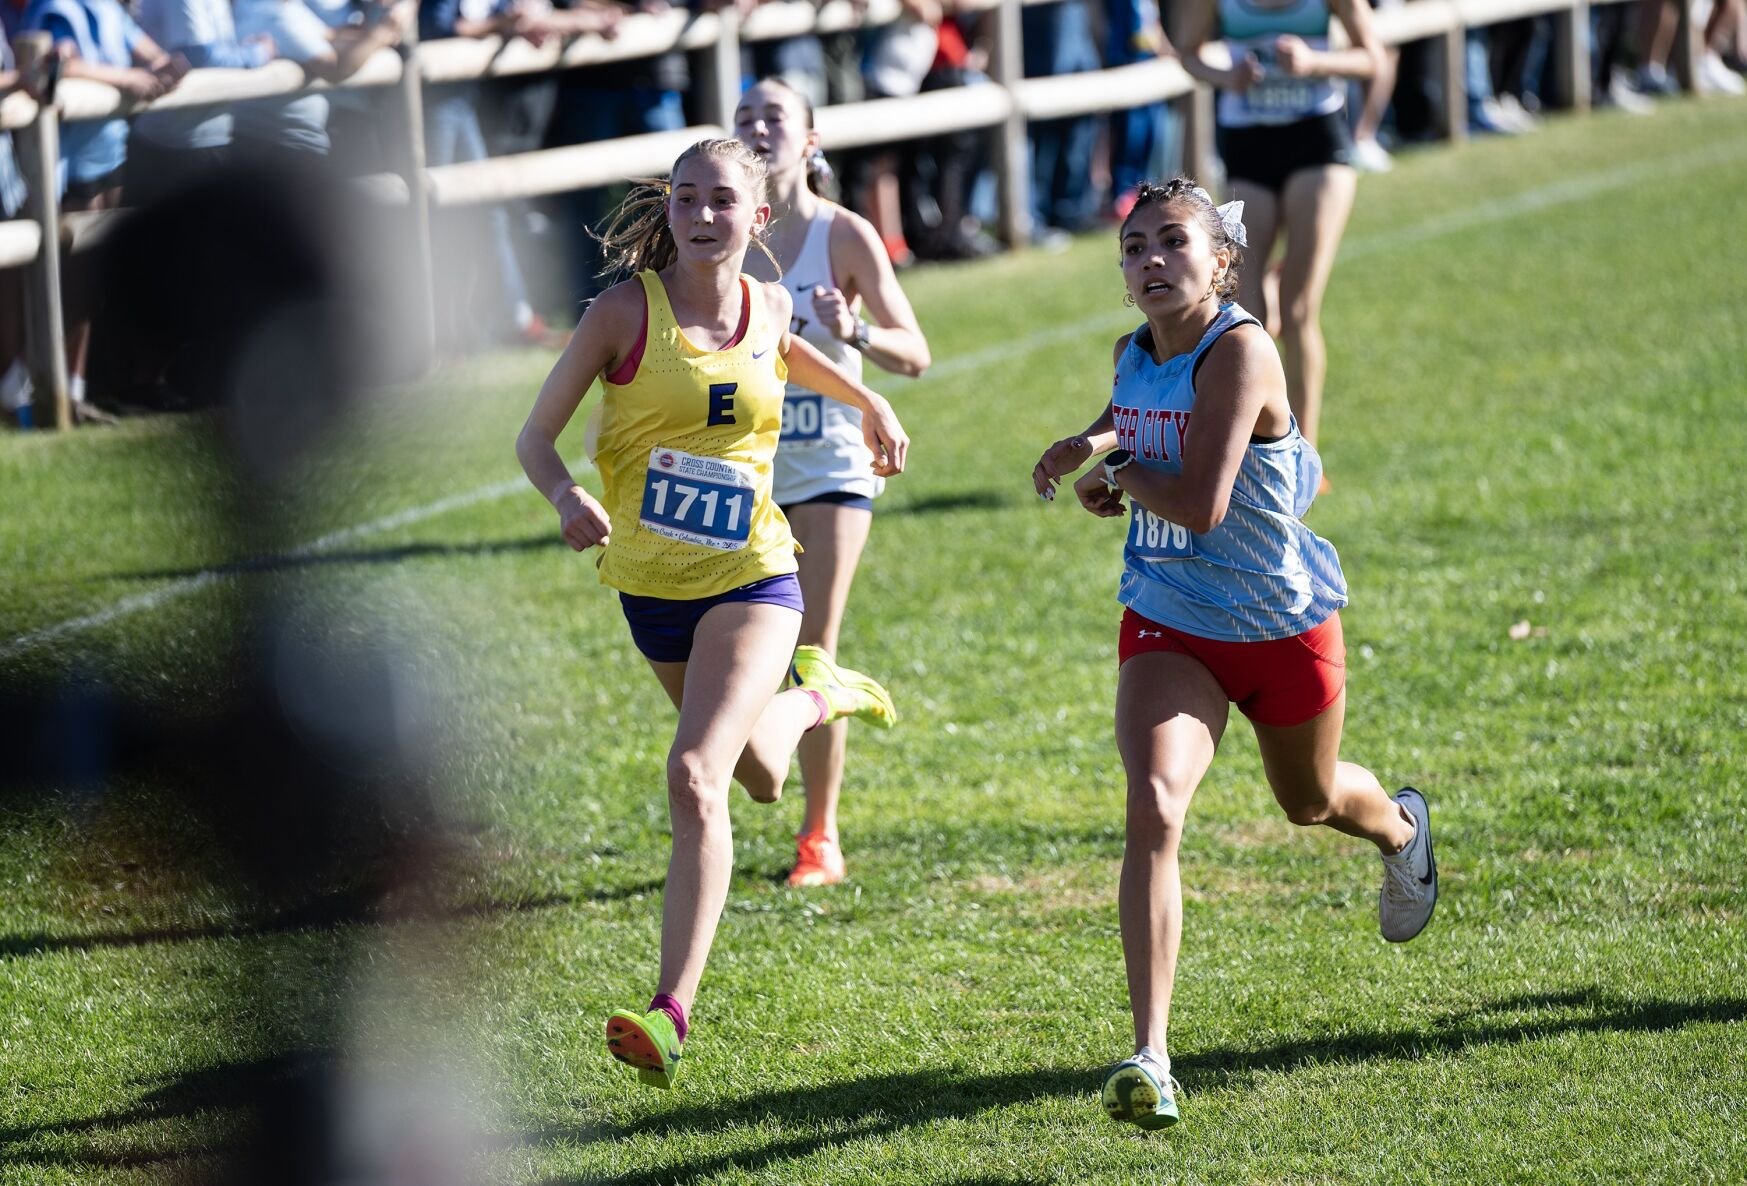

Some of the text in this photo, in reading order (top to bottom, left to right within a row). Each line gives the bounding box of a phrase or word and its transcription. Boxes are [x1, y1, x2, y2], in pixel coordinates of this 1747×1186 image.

[707, 382, 738, 427] E
[1141, 408, 1192, 462] CITY
[678, 465, 697, 476] STATE
[681, 456, 705, 469] CROSS
[651, 479, 743, 532] 1711
